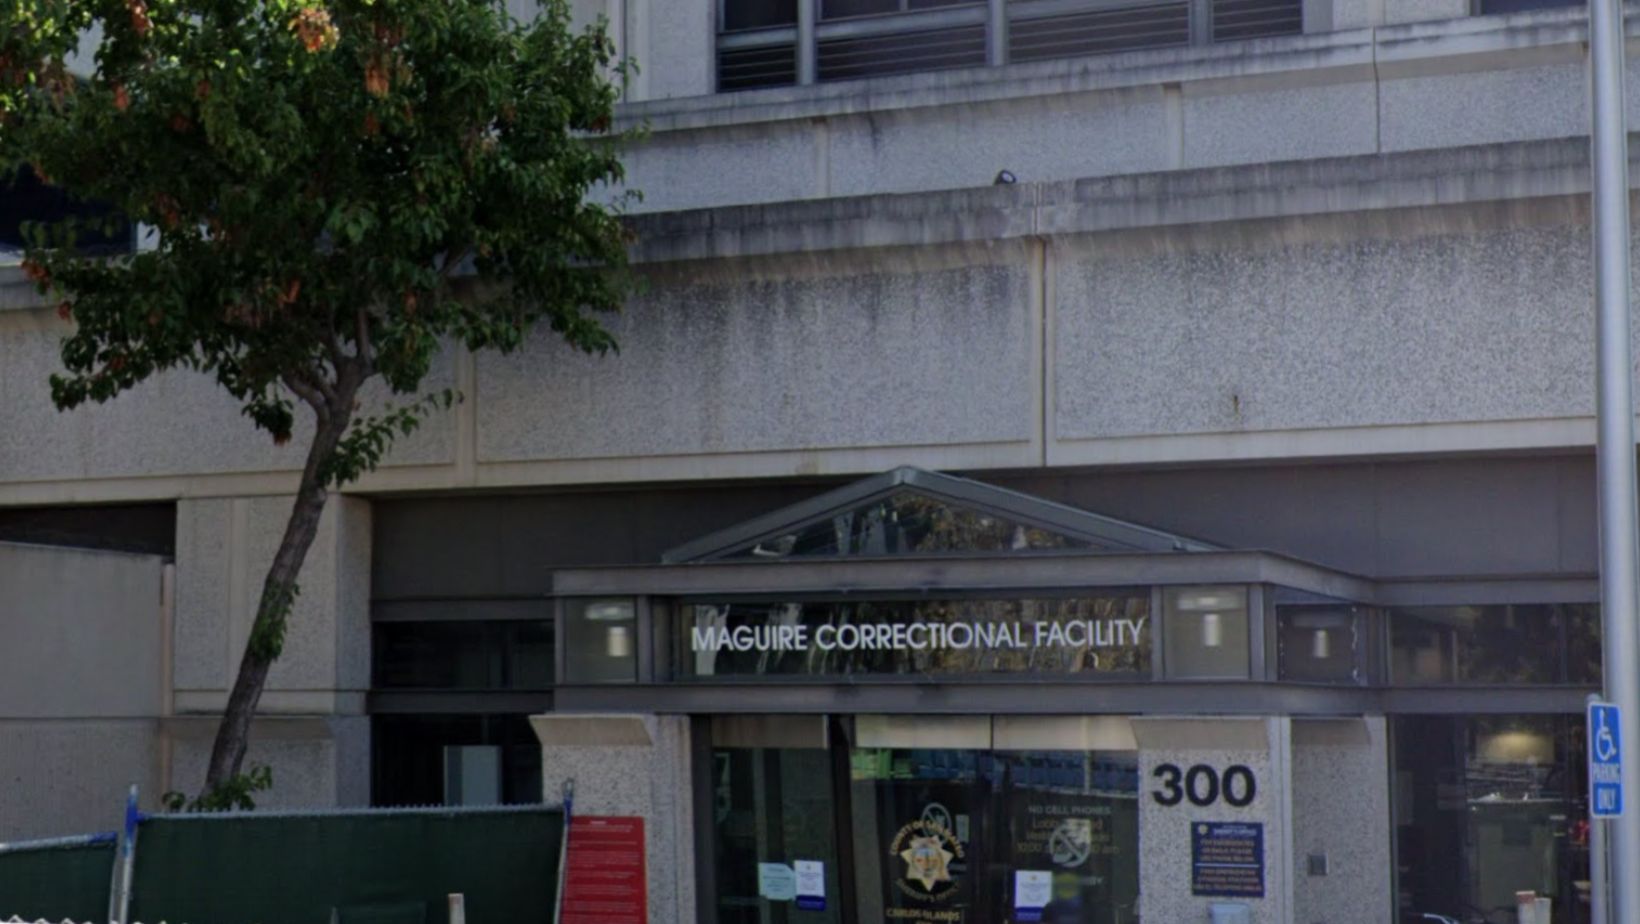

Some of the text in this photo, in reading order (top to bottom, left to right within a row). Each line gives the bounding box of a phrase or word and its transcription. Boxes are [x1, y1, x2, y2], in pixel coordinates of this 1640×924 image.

[691, 619, 1144, 651] MAGUIRE CORRECTIONAL FACILITY
[1592, 763, 1620, 784] PARKING
[1151, 762, 1257, 808] 300
[1597, 788, 1616, 809] ONLY
[1028, 805, 1112, 815] NO CELL PHONES
[890, 823, 912, 856] COUNTY
[886, 907, 922, 918] CARLOS
